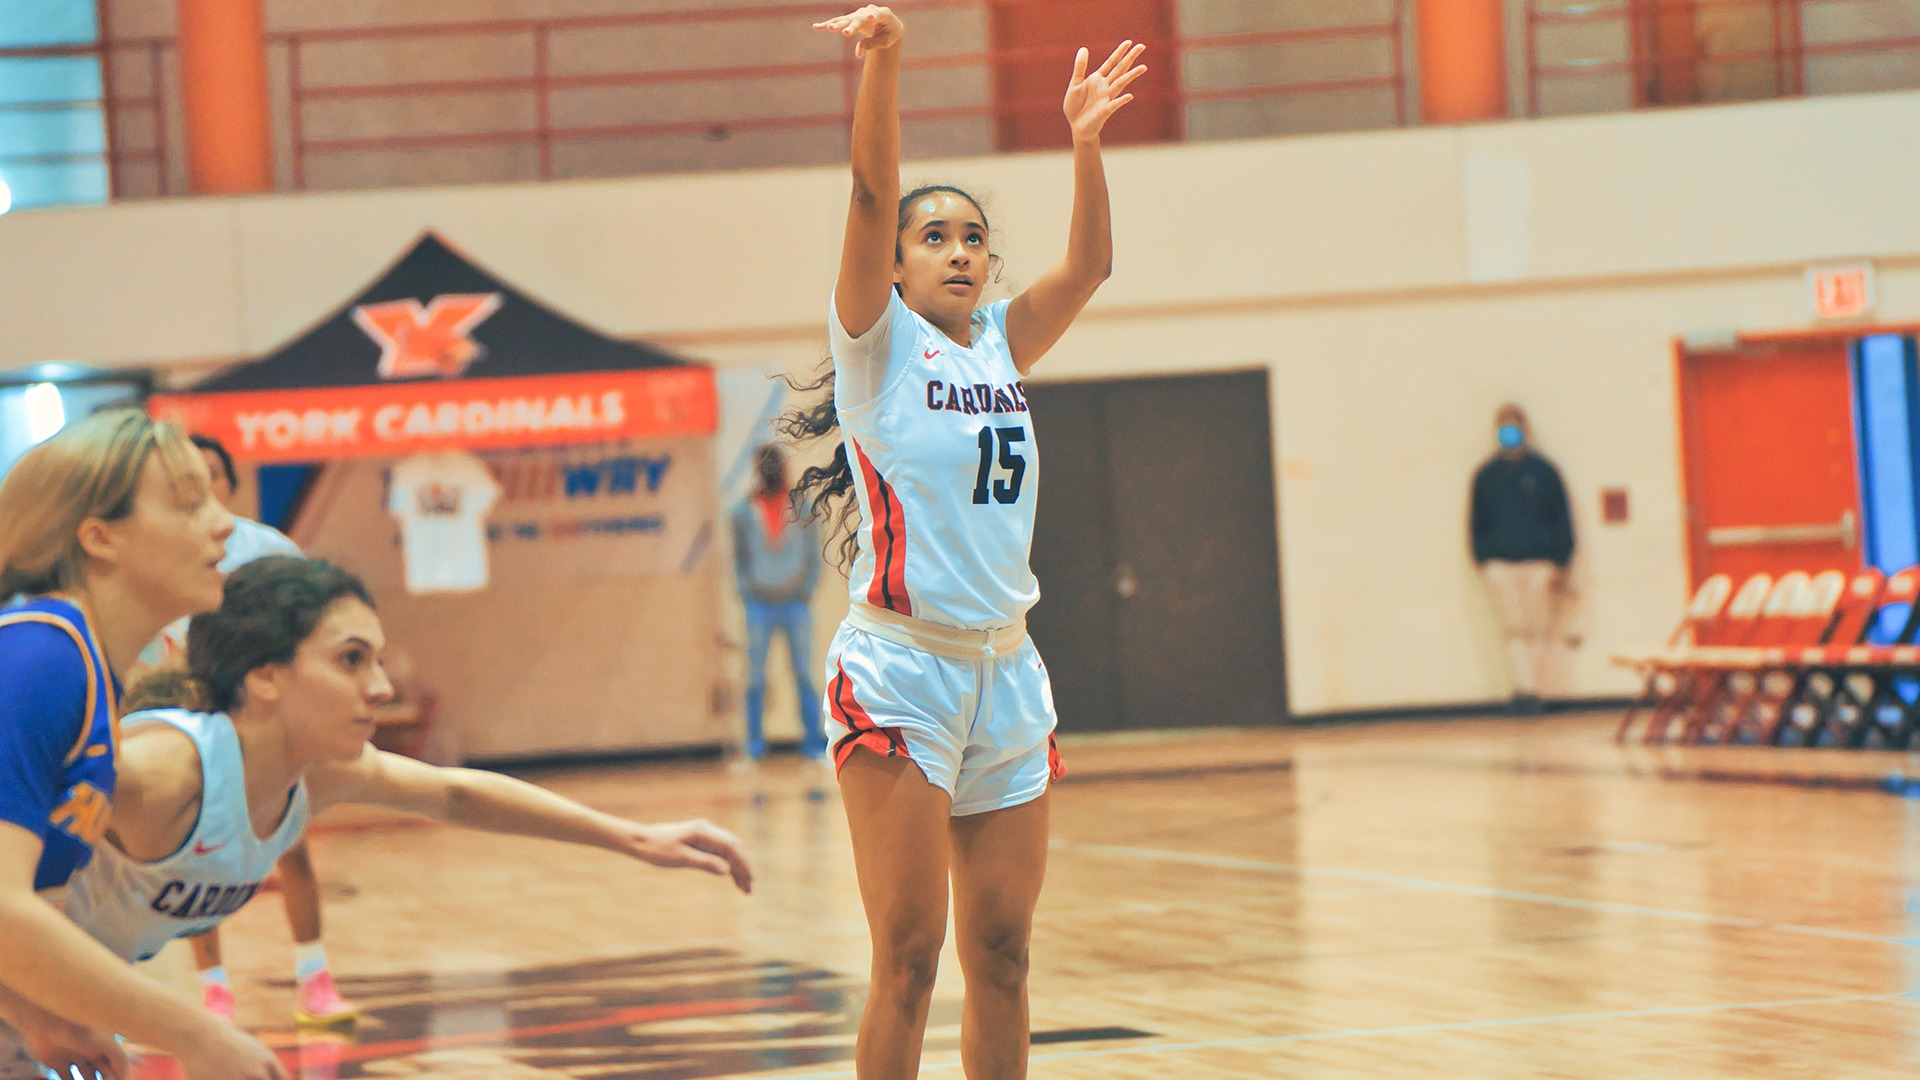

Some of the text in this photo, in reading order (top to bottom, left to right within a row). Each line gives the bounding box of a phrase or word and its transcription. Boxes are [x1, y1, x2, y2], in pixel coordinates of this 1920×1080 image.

[235, 408, 362, 449] YORK
[374, 391, 625, 440] CARDINALS
[926, 379, 1028, 415] CARDNLS
[972, 425, 1026, 504] 15
